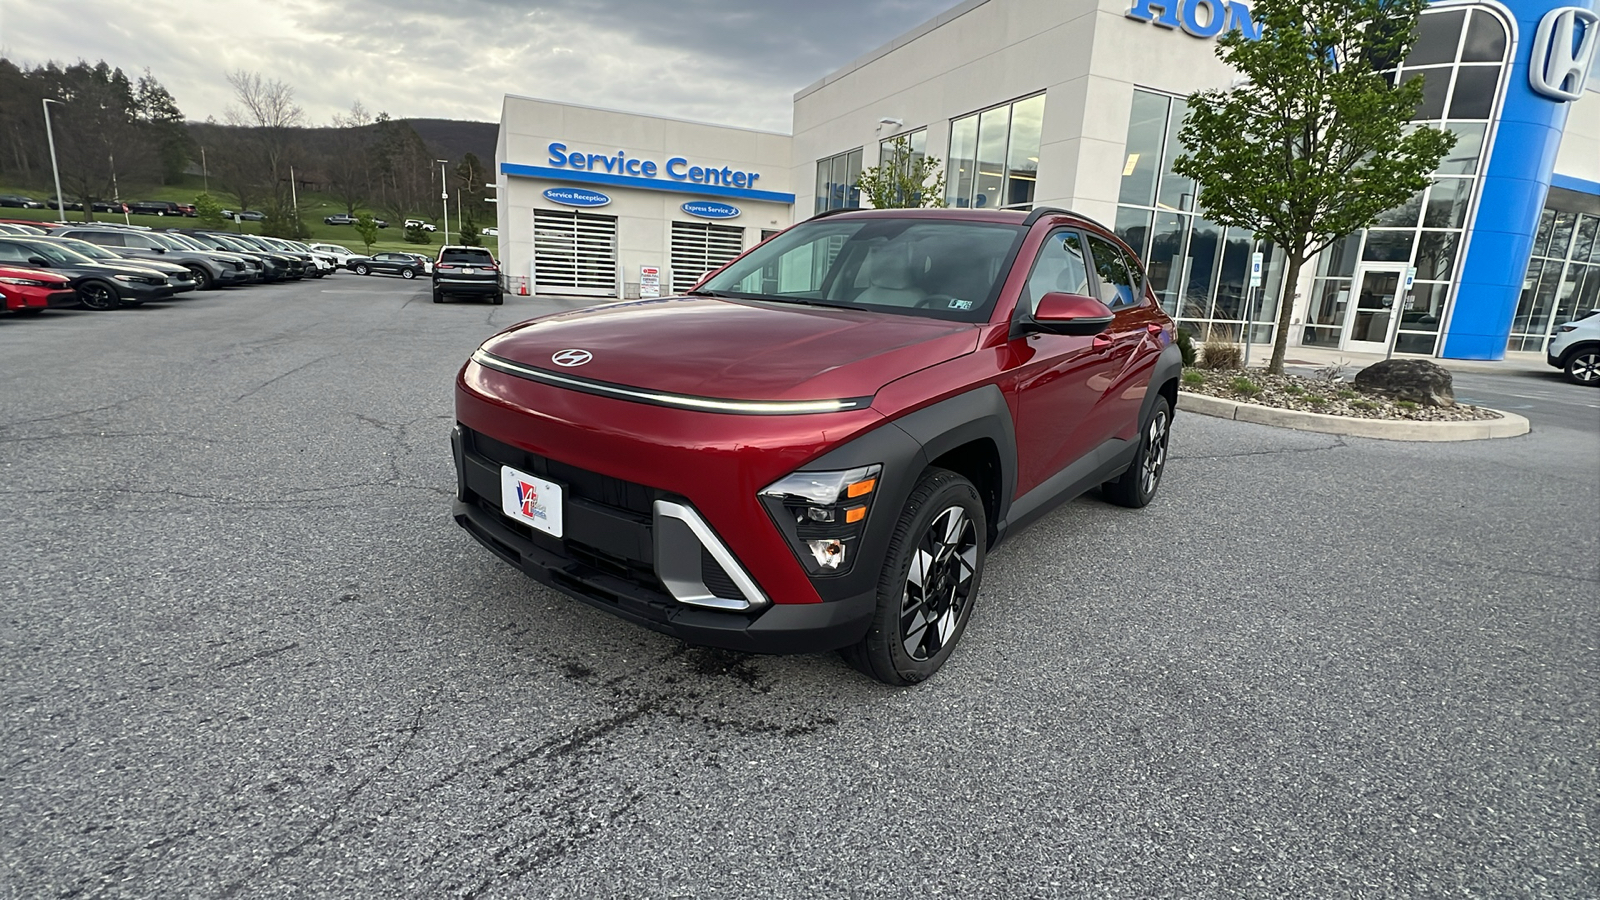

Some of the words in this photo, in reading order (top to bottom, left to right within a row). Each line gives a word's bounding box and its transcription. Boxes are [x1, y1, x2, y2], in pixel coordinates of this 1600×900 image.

[548, 142, 657, 178] Service
[665, 157, 760, 188] Center
[547, 190, 573, 199] Service
[573, 193, 607, 202] Reception
[684, 204, 707, 212] Express
[707, 206, 729, 214] Service
